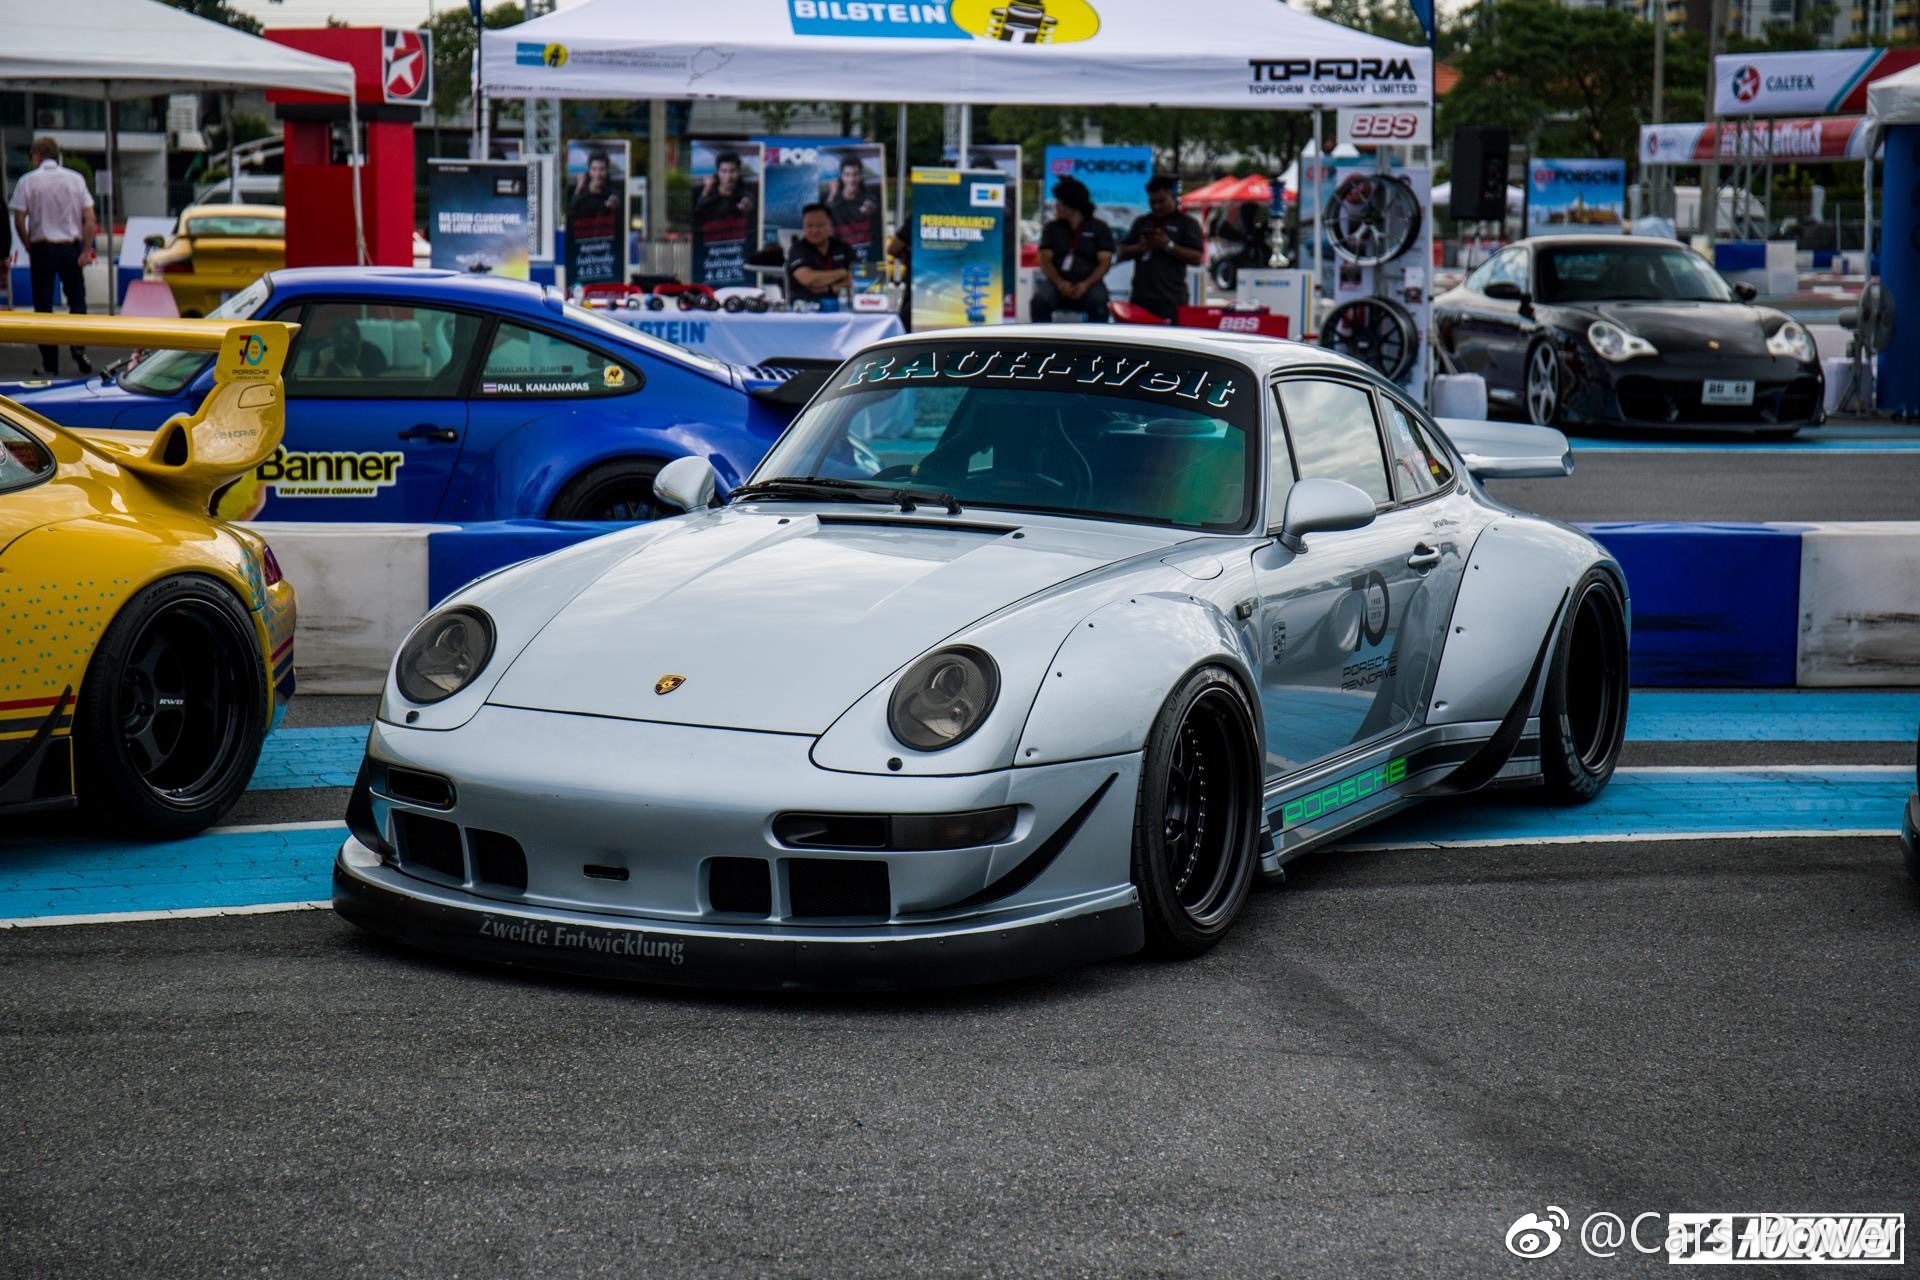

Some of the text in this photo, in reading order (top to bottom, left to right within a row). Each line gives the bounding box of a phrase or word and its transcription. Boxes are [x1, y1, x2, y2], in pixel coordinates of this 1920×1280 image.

[795, 1, 947, 24] BILSTEIN
[1249, 59, 1415, 81] TOPFORM
[1249, 84, 1417, 94] TOPFORM COMPANY LIMITED
[1766, 75, 1814, 91] CALTEX
[1351, 113, 1418, 138] BBS
[1218, 316, 1260, 332] BBS
[498, 382, 590, 392] PAUL KANJANAPAS
[840, 350, 1236, 408] RAUH-Welt
[257, 448, 400, 481] Banner
[279, 487, 374, 495] THE POWER COMPANY
[1343, 651, 1398, 679] PORSCHE
[1341, 665, 1397, 692] RENNDRIVE
[1283, 757, 1407, 829] PORSCHE
[479, 913, 684, 965] Zweite Entwicklung
